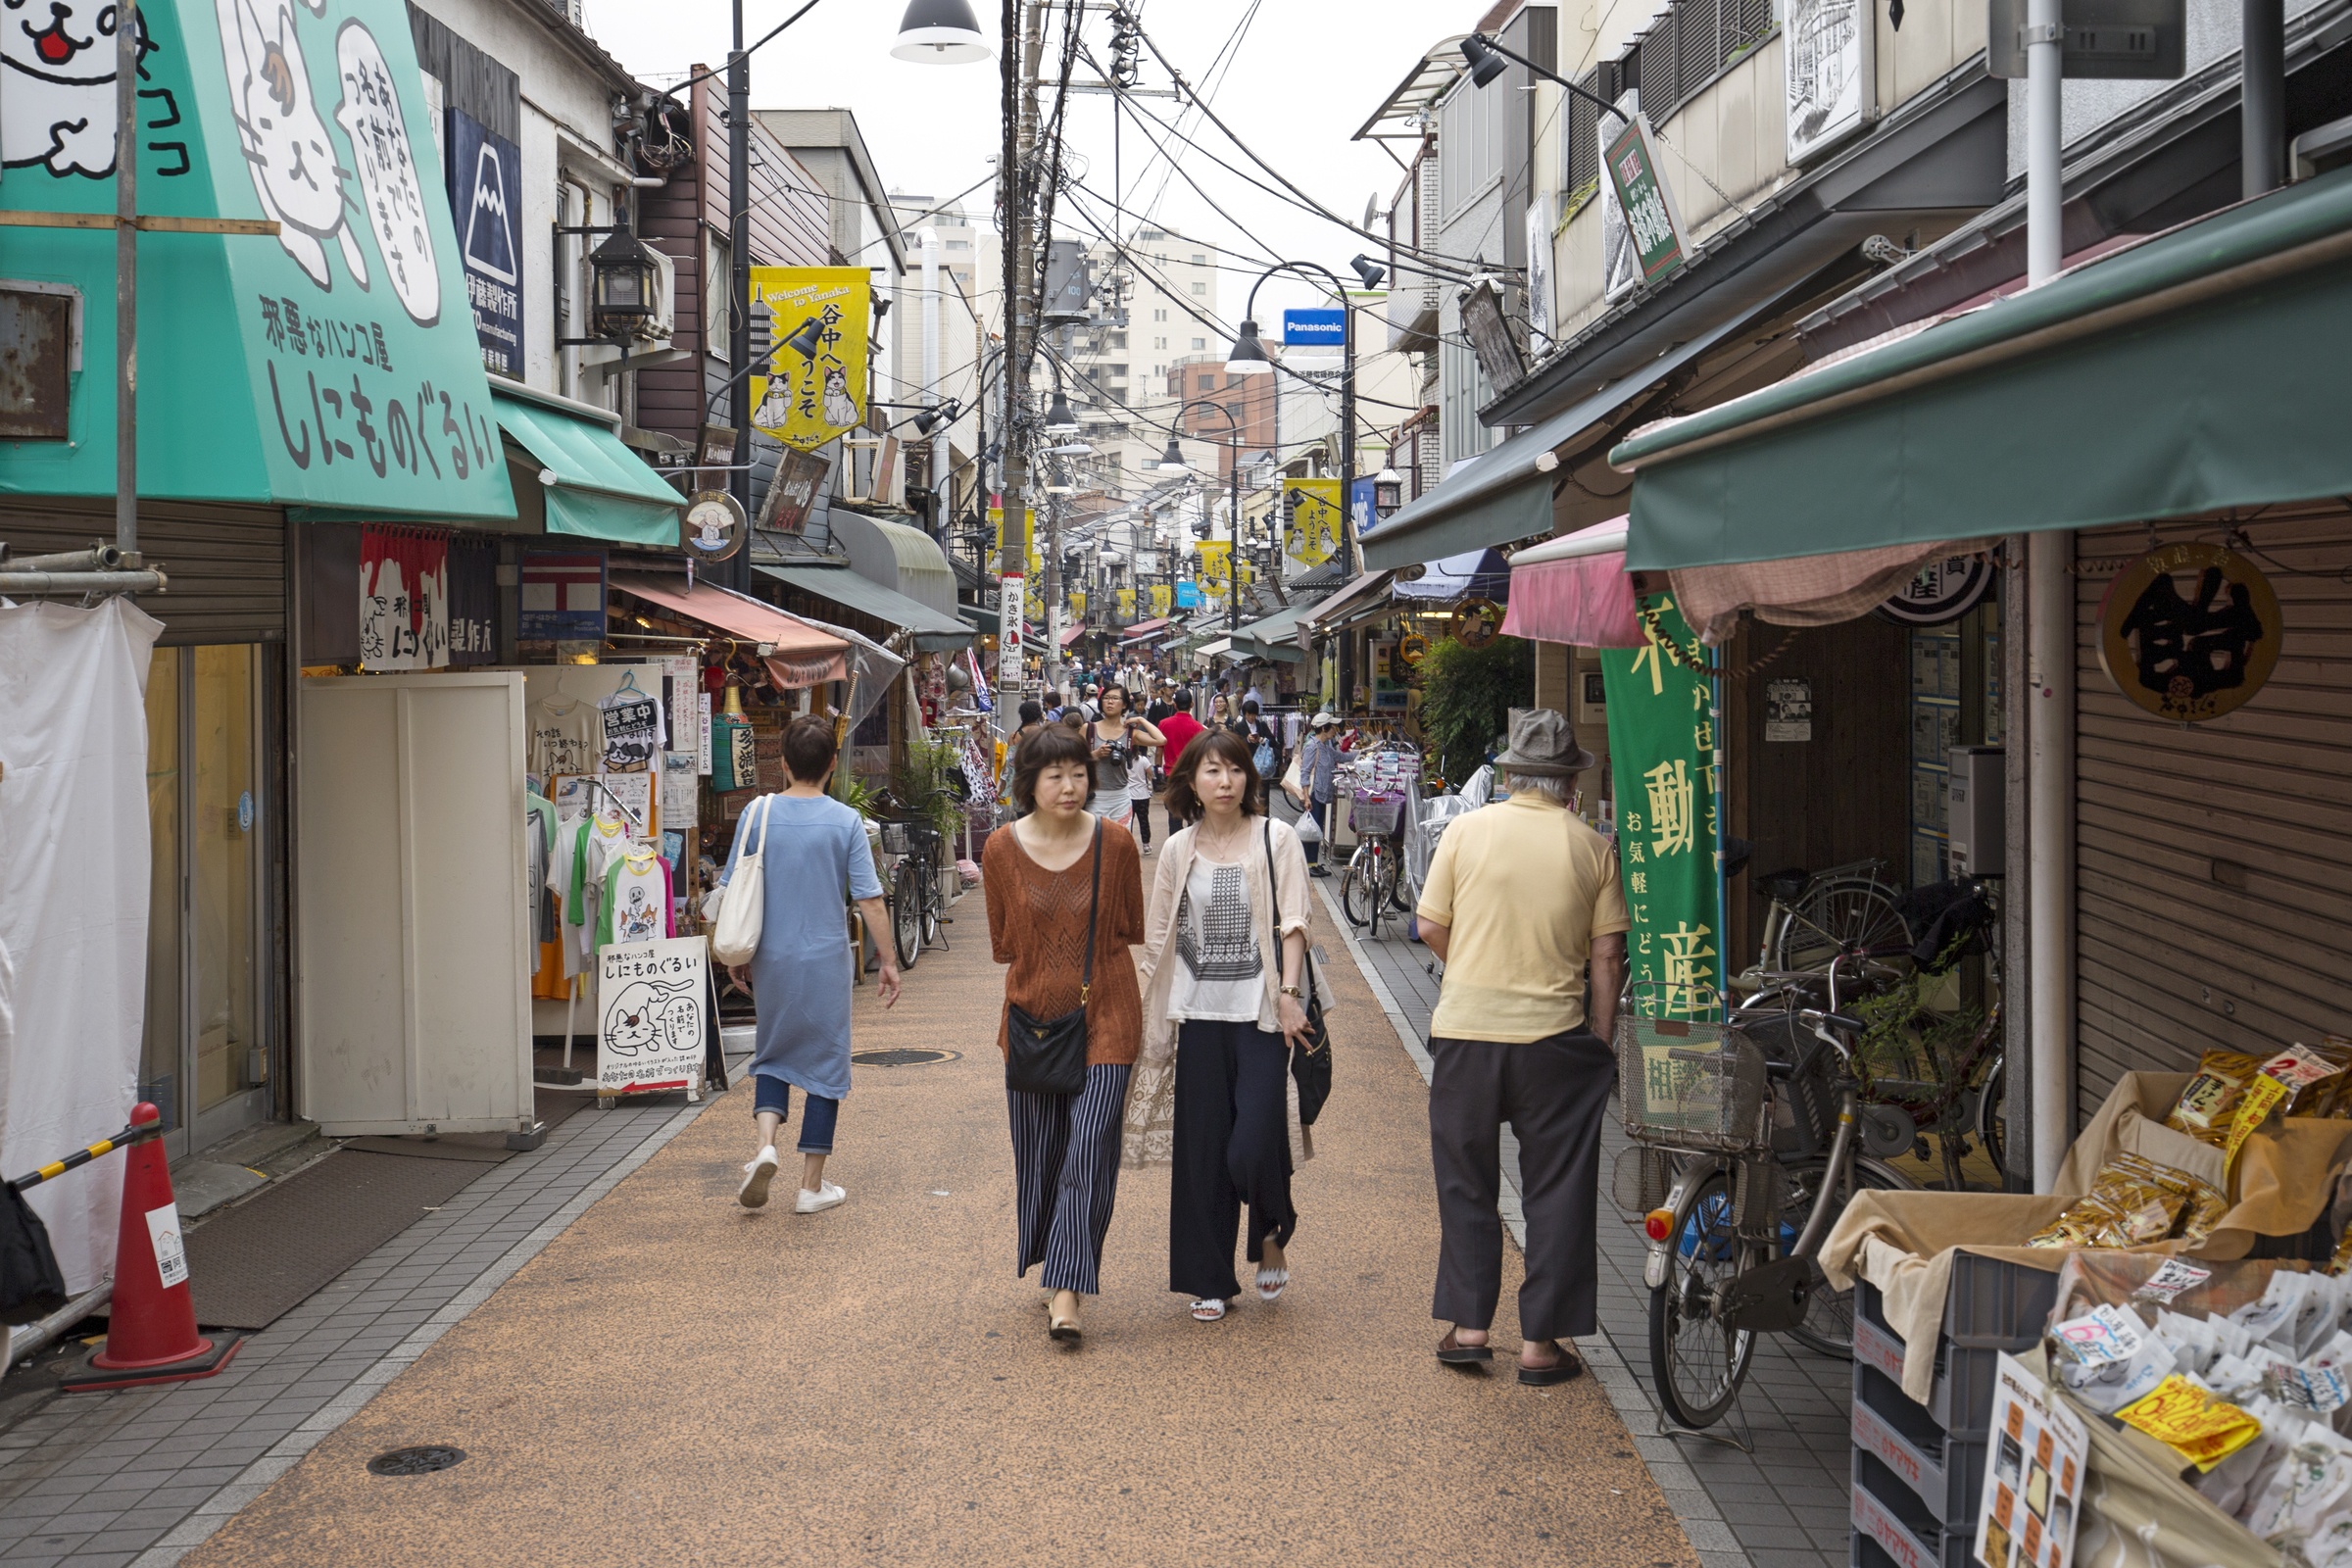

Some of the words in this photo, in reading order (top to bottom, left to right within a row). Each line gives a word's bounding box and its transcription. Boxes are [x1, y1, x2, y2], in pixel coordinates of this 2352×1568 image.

[358, 57, 402, 221] 名前で
[374, 61, 428, 263] あなたの
[345, 72, 410, 296] つくります
[465, 271, 517, 321] 伊藤製作所
[766, 283, 818, 304] Welcome
[794, 298, 806, 308] to
[808, 285, 851, 304] Yanaka
[259, 294, 394, 372] 邪悪なハンコ屋
[481, 321, 517, 347] manufacturing
[819, 304, 845, 366] 谷中へ
[1287, 321, 1343, 333] Panasonic
[798, 359, 816, 418] うこそ
[267, 360, 495, 480] しにものぐるい
[1316, 496, 1329, 527] 谷中へ
[1006, 591, 1019, 628] かき氷
[535, 727, 562, 739] その話
[605, 703, 652, 727] 営業中
[607, 719, 648, 735] お気軽にどうぞ
[1631, 596, 1722, 1017] 不動産
[1626, 810, 1655, 1016] お気軽にどうぞ
[606, 956, 697, 979] しにものぐるい
[607, 949, 656, 963] 邪悪なハンコ屋
[667, 1008, 678, 1046] つくります
[676, 1004, 686, 1033] 名前で
[686, 1002, 695, 1037] あなたの
